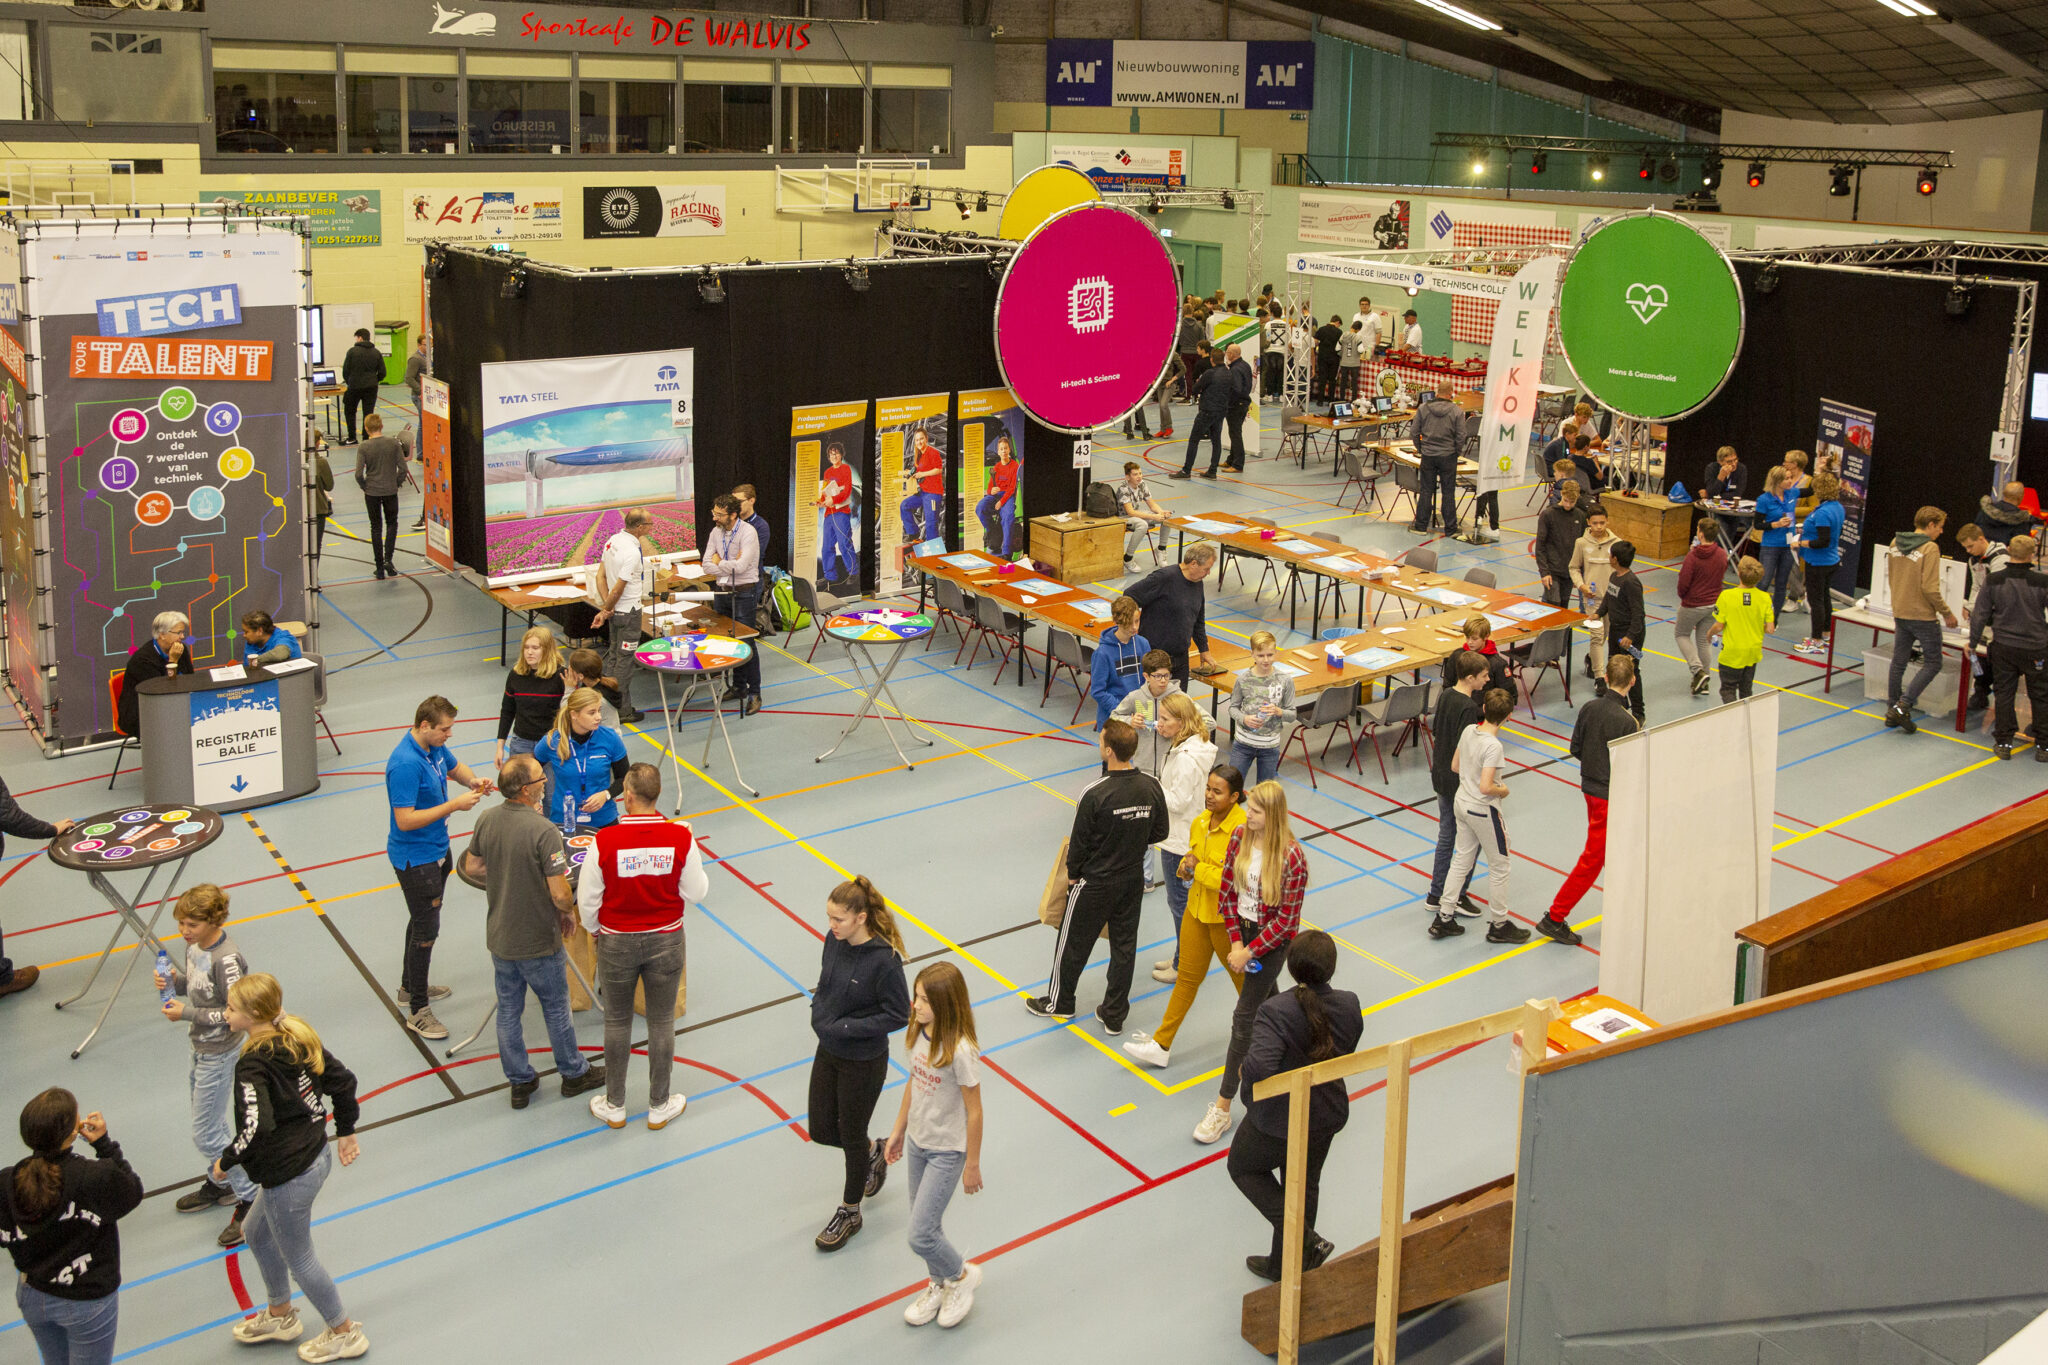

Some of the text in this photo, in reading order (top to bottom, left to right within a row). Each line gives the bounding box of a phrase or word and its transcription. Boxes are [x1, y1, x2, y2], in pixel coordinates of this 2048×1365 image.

[651, 15, 695, 46] DE
[705, 17, 811, 51] WALVIS
[1057, 60, 1097, 84] AM
[1117, 60, 1240, 76] Nieuwbouwwoning
[1256, 64, 1297, 87] AM
[1116, 91, 1239, 104] www.AMWONEN.nl
[1115, 175, 1165, 185] shwroom!
[244, 193, 338, 203] ZAANBEVER
[671, 202, 721, 218] RACING
[1328, 213, 1371, 223] MASTERMATE
[317, 235, 380, 244] 0251-227512
[1310, 263, 1342, 273] MARITIEM
[1343, 266, 1375, 278] COLLEGE
[1377, 271, 1410, 282] IJMUIDEN
[1432, 277, 1478, 292] TECHNISCH
[1480, 281, 1507, 295] COLLE
[102, 288, 236, 334] TECH
[1296, 331, 1300, 339] 3
[75, 342, 87, 375] YOUR
[90, 341, 268, 376] TALENT
[1061, 378, 1086, 388] Hi-tech
[1094, 373, 1121, 383] Science
[1608, 368, 1627, 376] Mens
[1634, 371, 1677, 382] Gezondheid
[654, 382, 680, 392] TATA
[499, 392, 559, 404] TATA STEEL
[678, 400, 686, 413] 8
[1821, 418, 1843, 431] BEZOEK
[156, 429, 198, 441] Ontdek
[170, 441, 185, 450] de
[1999, 437, 2005, 449] 1
[146, 450, 208, 463] 7 werelden
[1075, 444, 1089, 456] 43
[168, 463, 188, 472] van
[154, 472, 203, 484] techniek
[196, 726, 277, 749] REGISTRATIE
[219, 742, 256, 757] BALIE
[626, 862, 643, 871] NET
